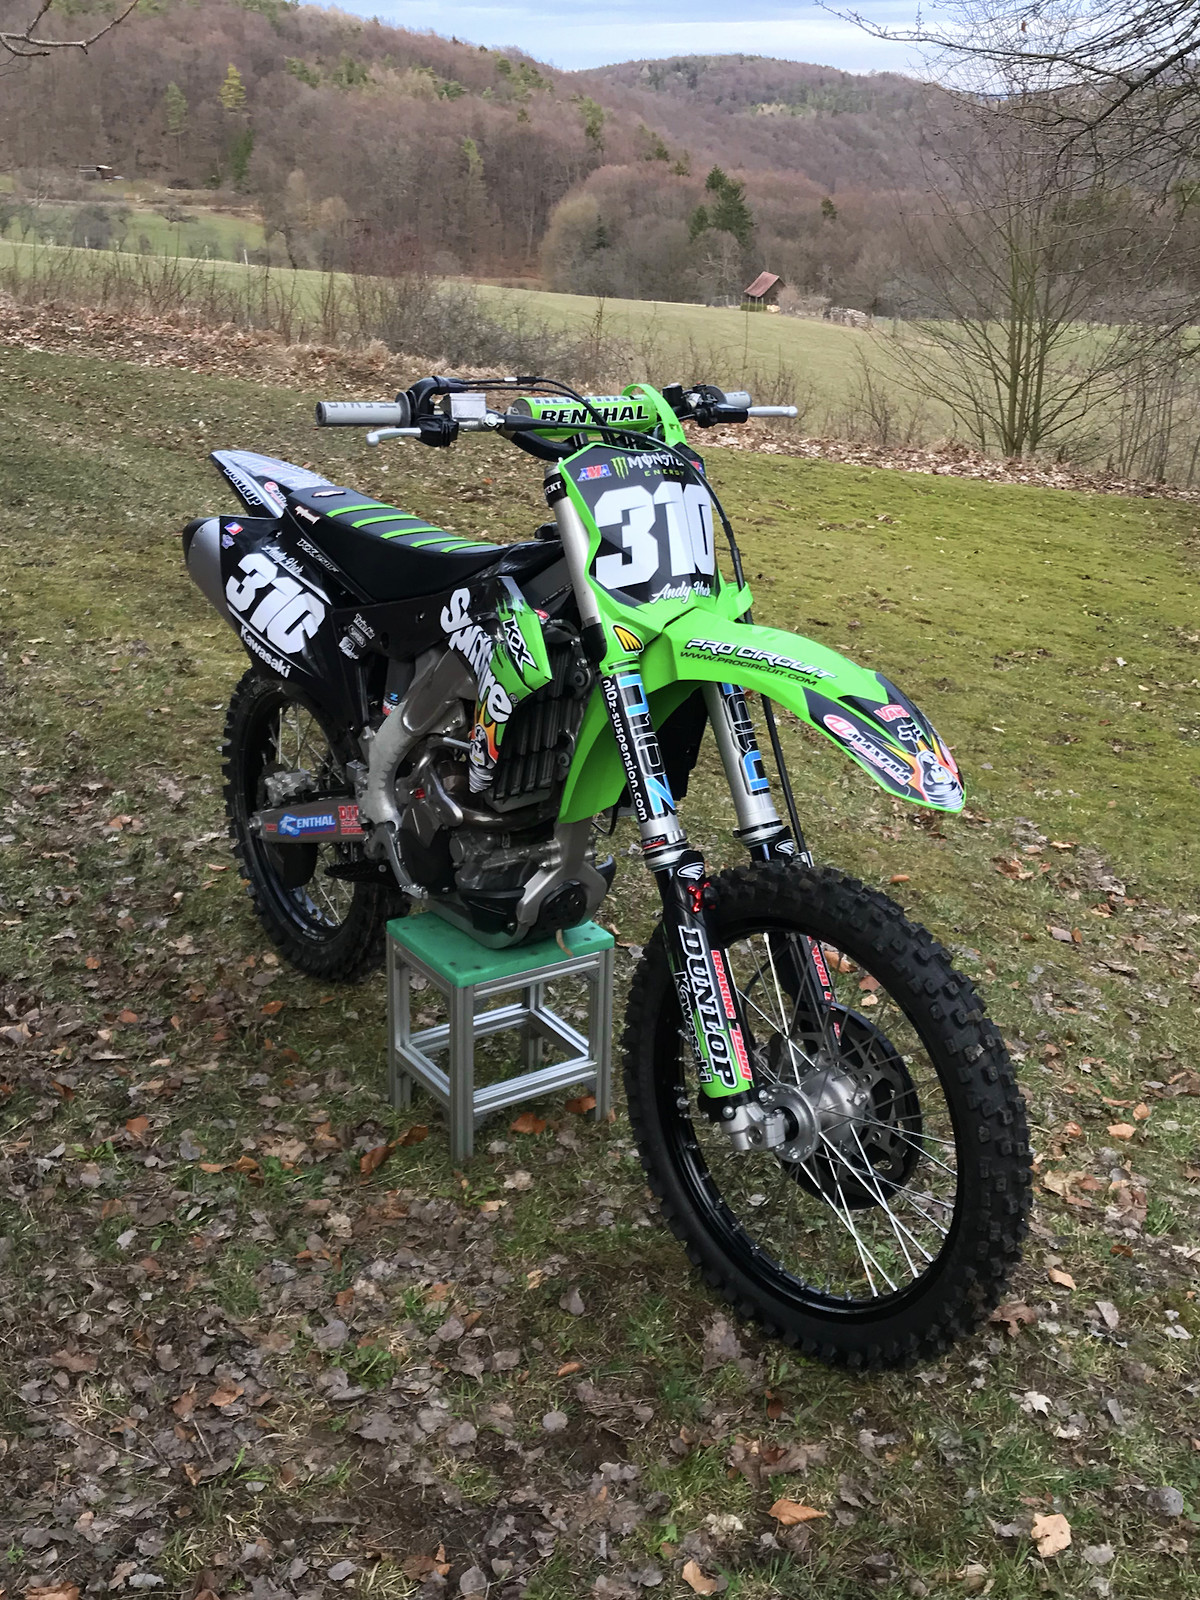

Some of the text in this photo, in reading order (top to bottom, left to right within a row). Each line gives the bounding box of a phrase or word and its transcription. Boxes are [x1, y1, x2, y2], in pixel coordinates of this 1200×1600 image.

[644, 469, 685, 477] ENERGY
[594, 481, 715, 590] 310
[650, 581, 692, 603] Andy
[240, 625, 291, 678] Kawasaki
[503, 615, 539, 673] KX
[680, 651, 817, 686] WWW.PROCIRCUIT.COM
[685, 638, 838, 679] PRO CIRCUIT
[678, 925, 738, 1088] DUNLOP
[711, 950, 736, 1019] BRAKING
[673, 970, 713, 1083] Kawasaki
